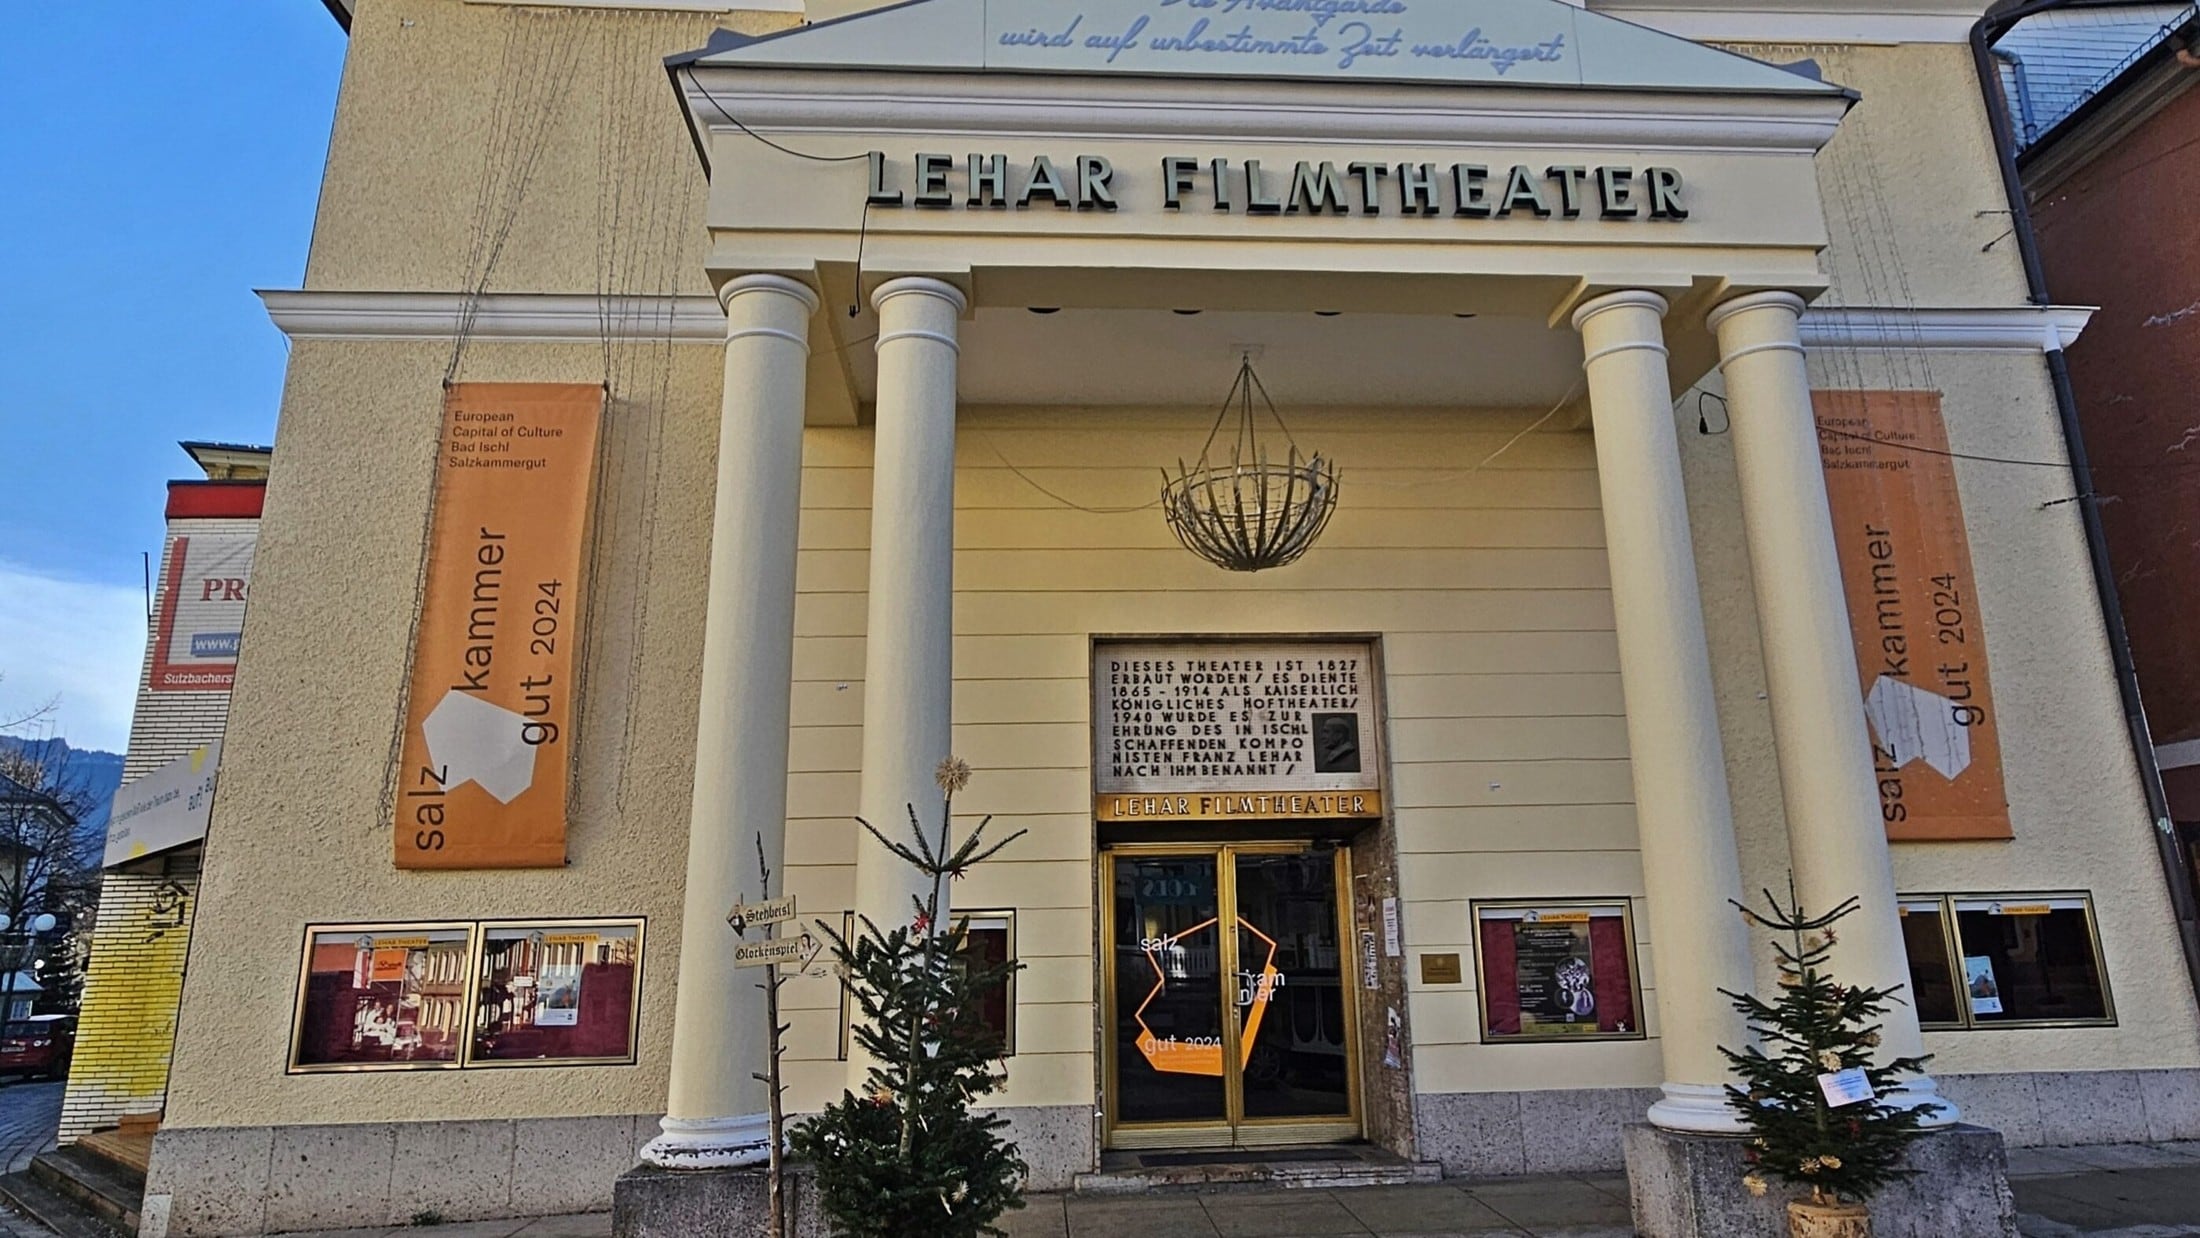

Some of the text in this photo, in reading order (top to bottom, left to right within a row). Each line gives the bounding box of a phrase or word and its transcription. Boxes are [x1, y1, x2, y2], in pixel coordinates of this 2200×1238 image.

[999, 14, 1565, 75] wird auf unbestimmte Zeit verlängert
[867, 151, 1690, 221] LEHAR FILMTHEATER
[454, 410, 514, 423] European
[452, 426, 563, 438] Capital of Culture
[1874, 430, 1915, 440] Culture
[451, 441, 510, 452] Bad Ischl
[449, 456, 546, 470] Salzkammergut
[1865, 524, 1908, 676] kammer
[451, 527, 506, 692] kammer
[1931, 573, 1984, 727] gut 2024
[520, 578, 562, 746] gut 2024
[1111, 660, 1357, 672] DIESES THEATER IST 1827
[1111, 674, 1172, 684] ERBAUT
[1181, 673, 1248, 684] WORDEN
[1272, 673, 1290, 683] ES
[1301, 673, 1357, 684] DIENTE
[1112, 686, 1151, 697] 1865
[1175, 686, 1210, 697] 1914
[1221, 686, 1251, 696] ALS
[1264, 685, 1358, 696] KAISERLICH
[1112, 698, 1225, 710] KÖNIGLICHES
[1114, 711, 1302, 723] 1940 WURDE ES ZUR
[1192, 724, 1223, 736] DES
[1235, 725, 1252, 735] IN
[1263, 724, 1309, 735] ISCHL
[1113, 738, 1304, 750] SCHAFFENDEN KOMPO
[1112, 751, 1302, 763] NISTEN FRANZ LEHAR
[1113, 765, 1160, 777] NACH
[1873, 742, 1907, 823] salz
[407, 764, 448, 852] salz
[1113, 795, 1366, 816] LEHAR FILMTHEATER
[745, 903, 791, 922] Stehbeisl
[1140, 933, 1178, 951] salz
[735, 942, 799, 961] Glockenspiel
[1144, 1034, 1221, 1056] gut 2024
